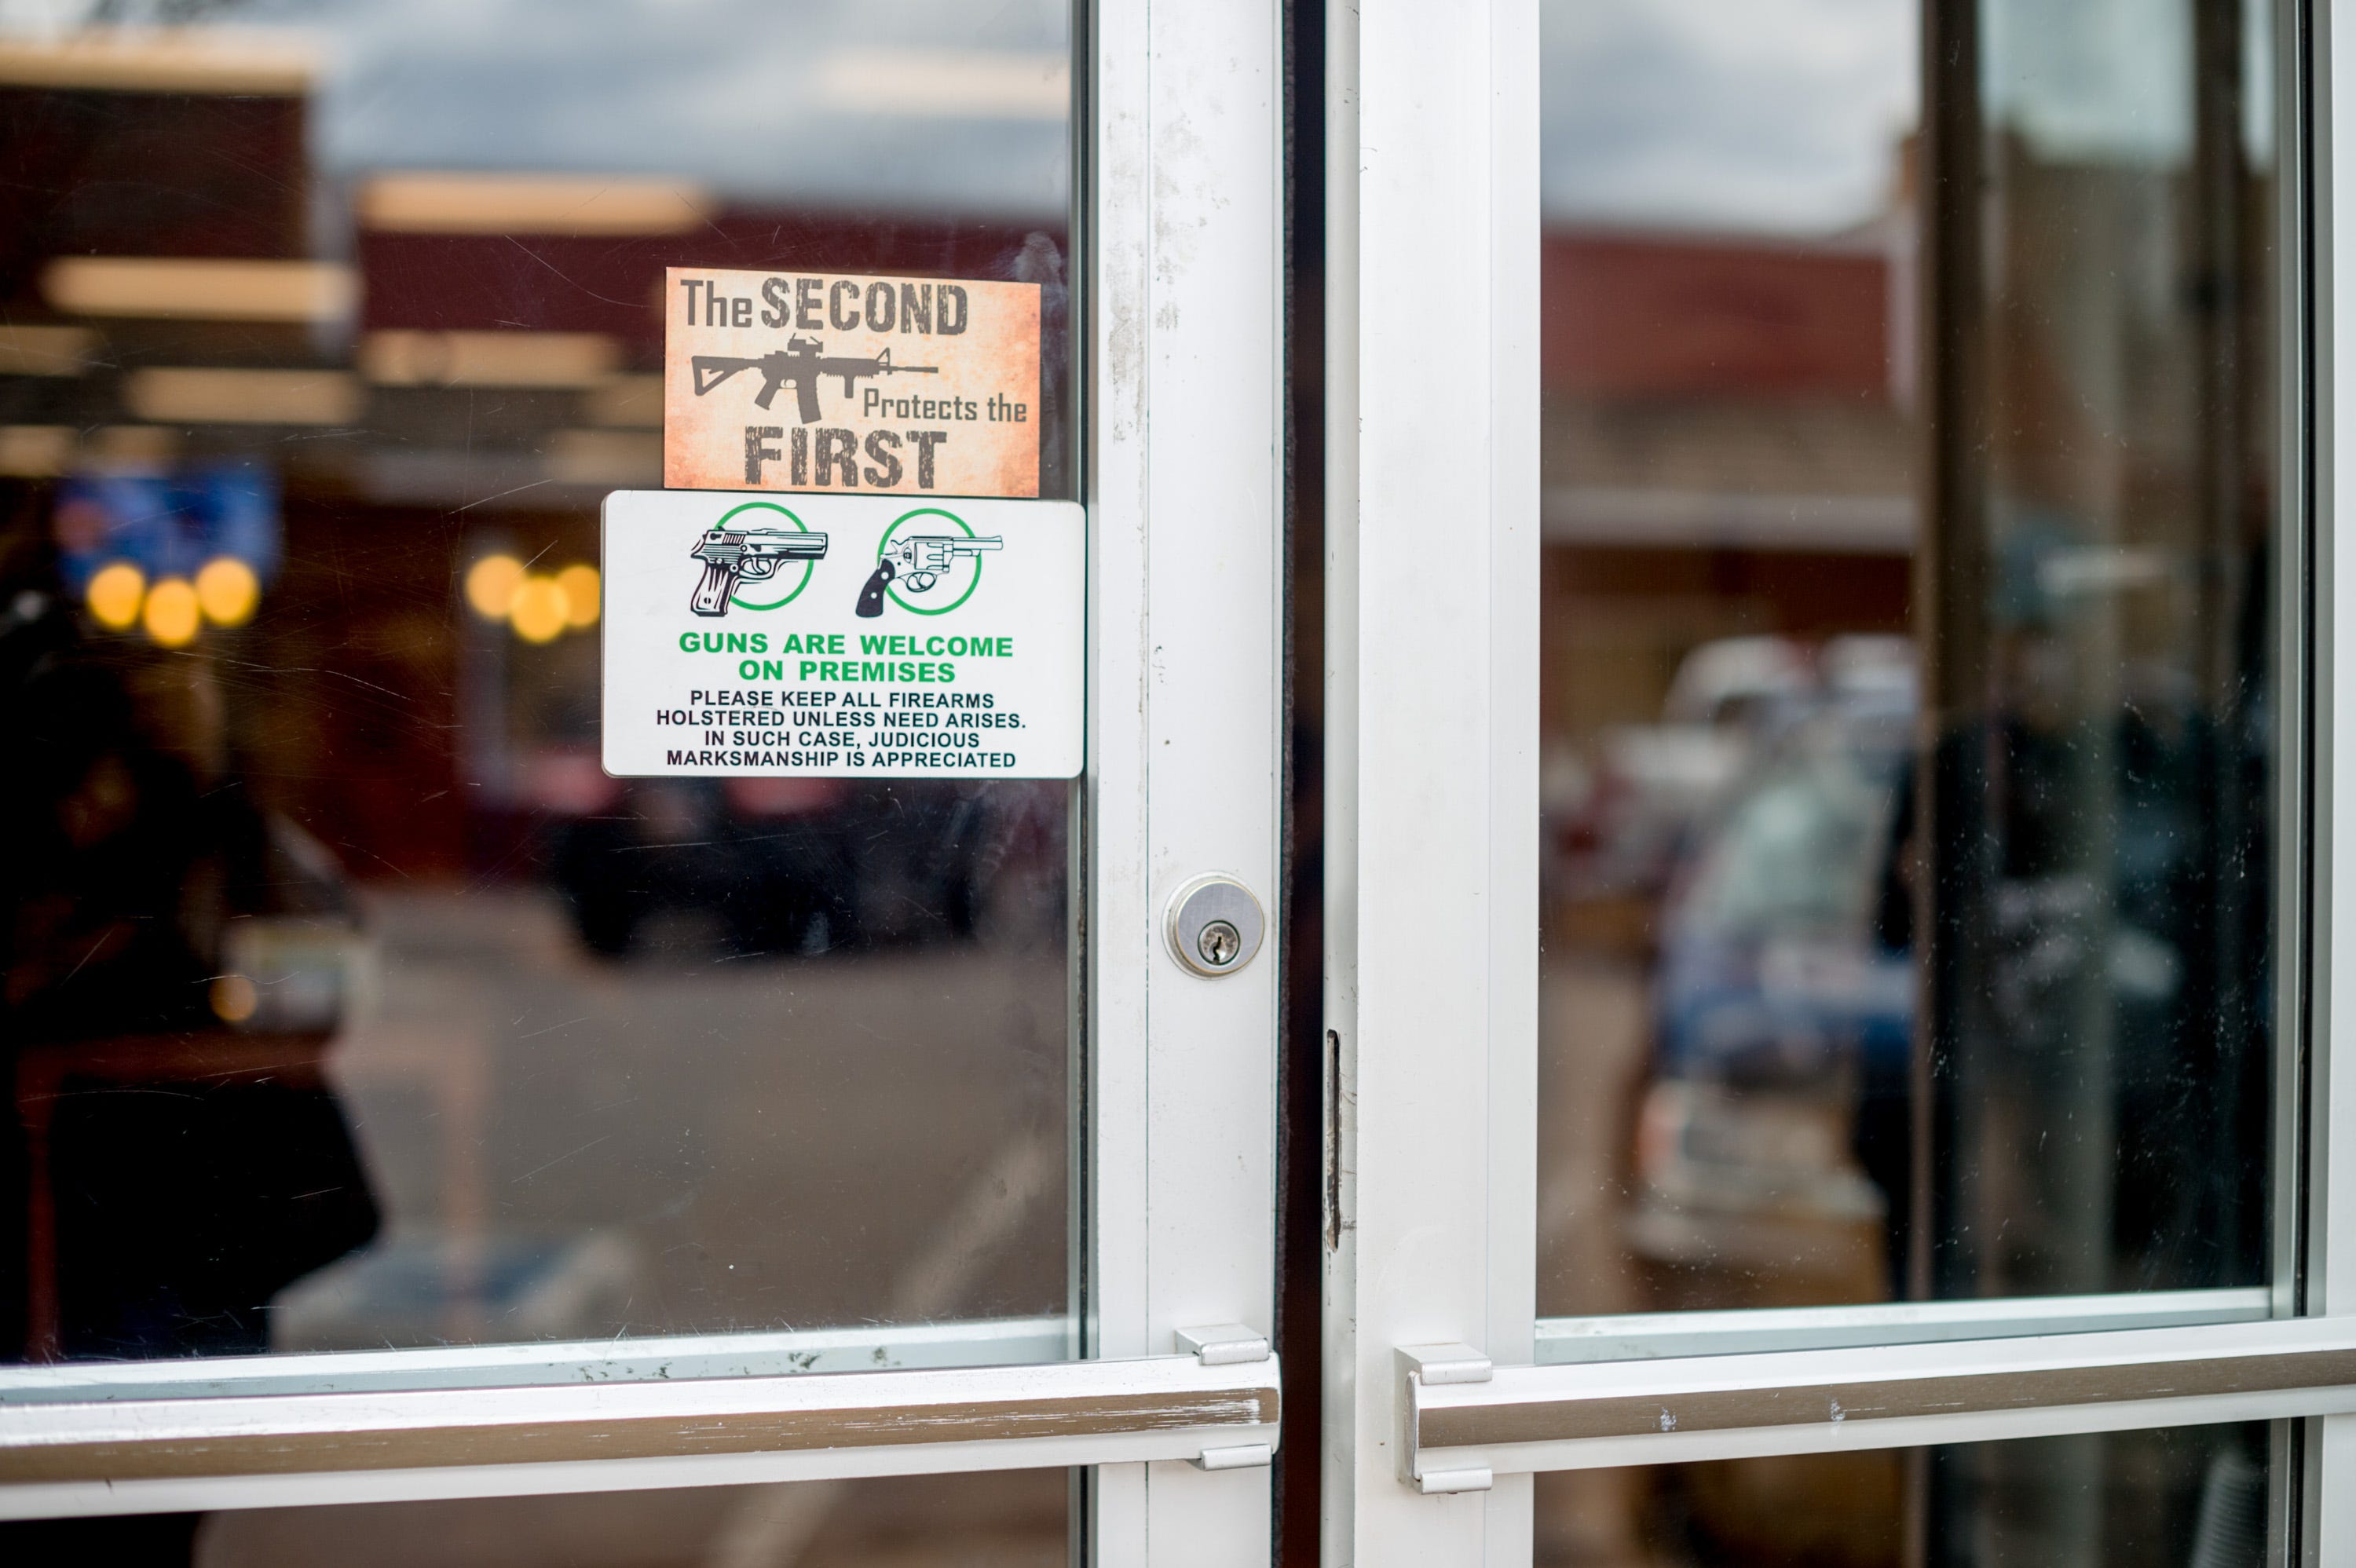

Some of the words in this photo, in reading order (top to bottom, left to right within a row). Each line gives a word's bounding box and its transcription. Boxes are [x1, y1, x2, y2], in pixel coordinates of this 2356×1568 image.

[681, 280, 752, 327] The
[762, 277, 967, 335] SECOND
[865, 389, 977, 420] Protects
[987, 393, 1026, 422] the
[745, 426, 947, 488] FIRST
[679, 632, 768, 653] GUNS
[783, 634, 845, 654] ARE
[860, 635, 1012, 656] WELCOME
[739, 660, 782, 680] ON
[800, 661, 955, 682] PREMISES
[691, 690, 773, 706] PLEASE
[782, 691, 836, 707] KEEP
[842, 693, 881, 707] ALL
[890, 693, 993, 708] FIREARMS
[657, 710, 784, 726] HOLSTERED
[794, 711, 875, 727] UNLESS
[884, 712, 938, 727] NEED
[946, 713, 1026, 728] ARISES.
[706, 731, 724, 745] IN
[734, 731, 789, 746] SUCH
[799, 732, 860, 749] CASE,
[869, 732, 979, 747] JUDICIOUS
[668, 750, 838, 766] MARKSMANSHIP
[847, 752, 865, 766] IS
[872, 752, 1015, 767] APPRECIATED
